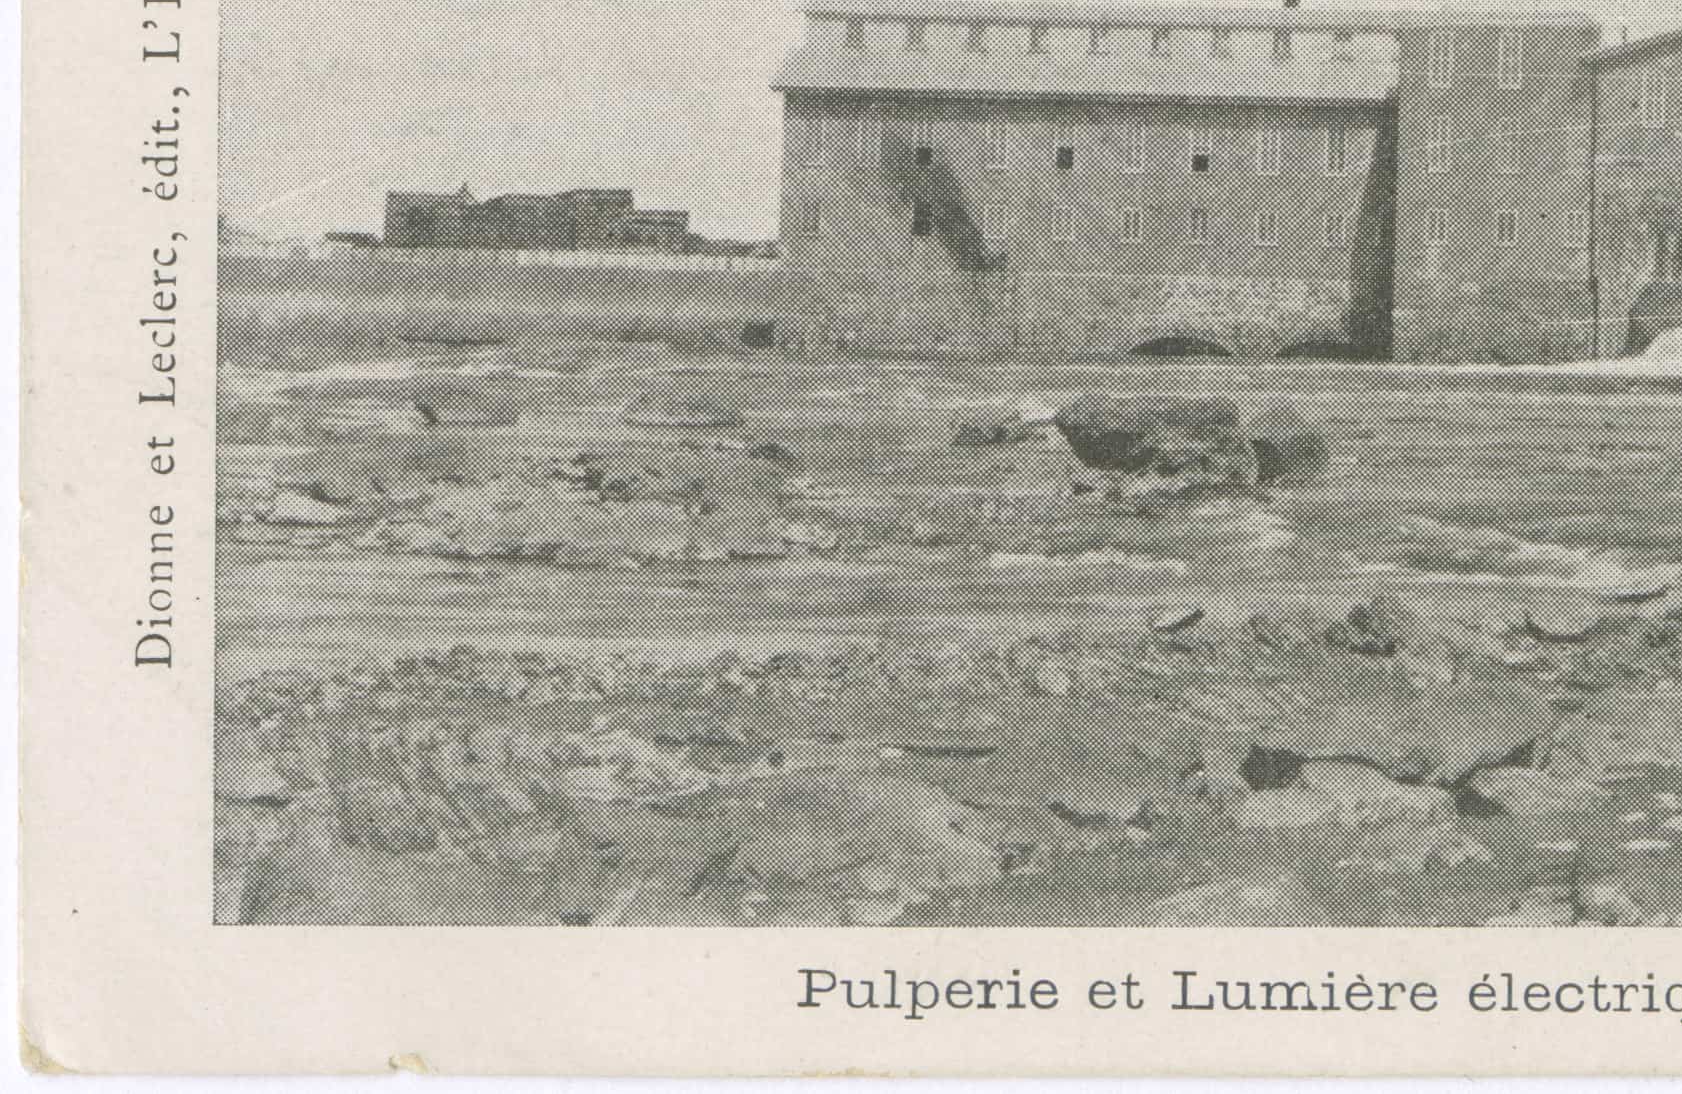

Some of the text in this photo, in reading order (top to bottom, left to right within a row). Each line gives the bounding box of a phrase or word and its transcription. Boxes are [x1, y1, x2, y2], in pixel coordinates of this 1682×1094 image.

[141, 86, 190, 201] édit.,
[138, 232, 188, 406] Leclerc,
[147, 436, 175, 475] et
[134, 505, 174, 668] Dionne
[797, 968, 1059, 1020] Pulperie
[1088, 973, 1144, 1010] et
[1171, 969, 1438, 1012] Lumière
